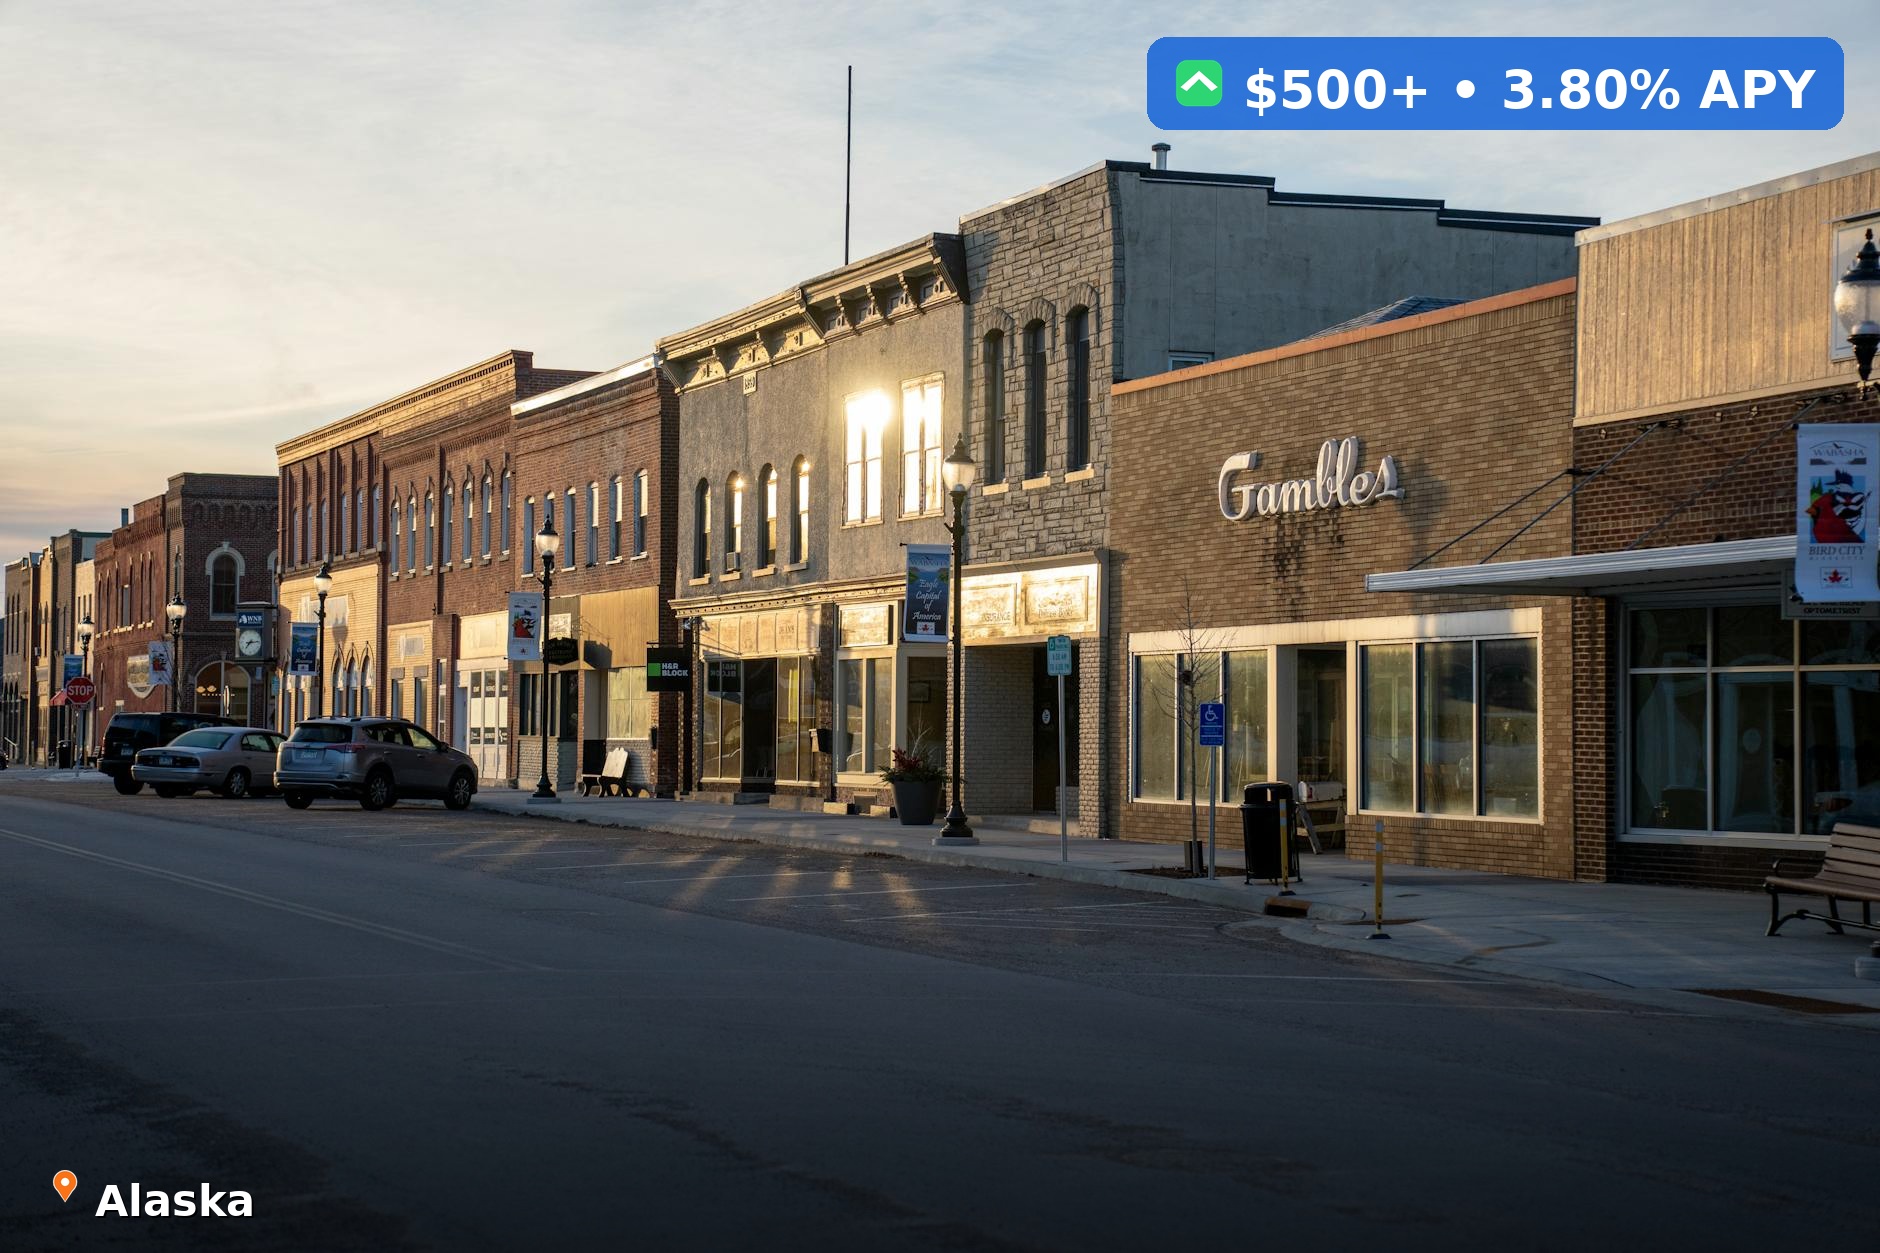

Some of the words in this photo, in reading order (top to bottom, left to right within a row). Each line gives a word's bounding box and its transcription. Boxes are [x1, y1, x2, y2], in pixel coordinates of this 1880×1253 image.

[1812, 448, 1865, 457] WABASHA
[1219, 435, 1405, 522] Gambles
[1808, 545, 1837, 556] BIRD
[1838, 545, 1866, 555] CITY
[919, 579, 939, 592] Eagle
[915, 590, 942, 604] Capital
[924, 599, 933, 612] of
[912, 611, 942, 621] America
[661, 662, 679, 670] H&R
[661, 669, 689, 677] BLOCK
[67, 685, 94, 696] STOP
